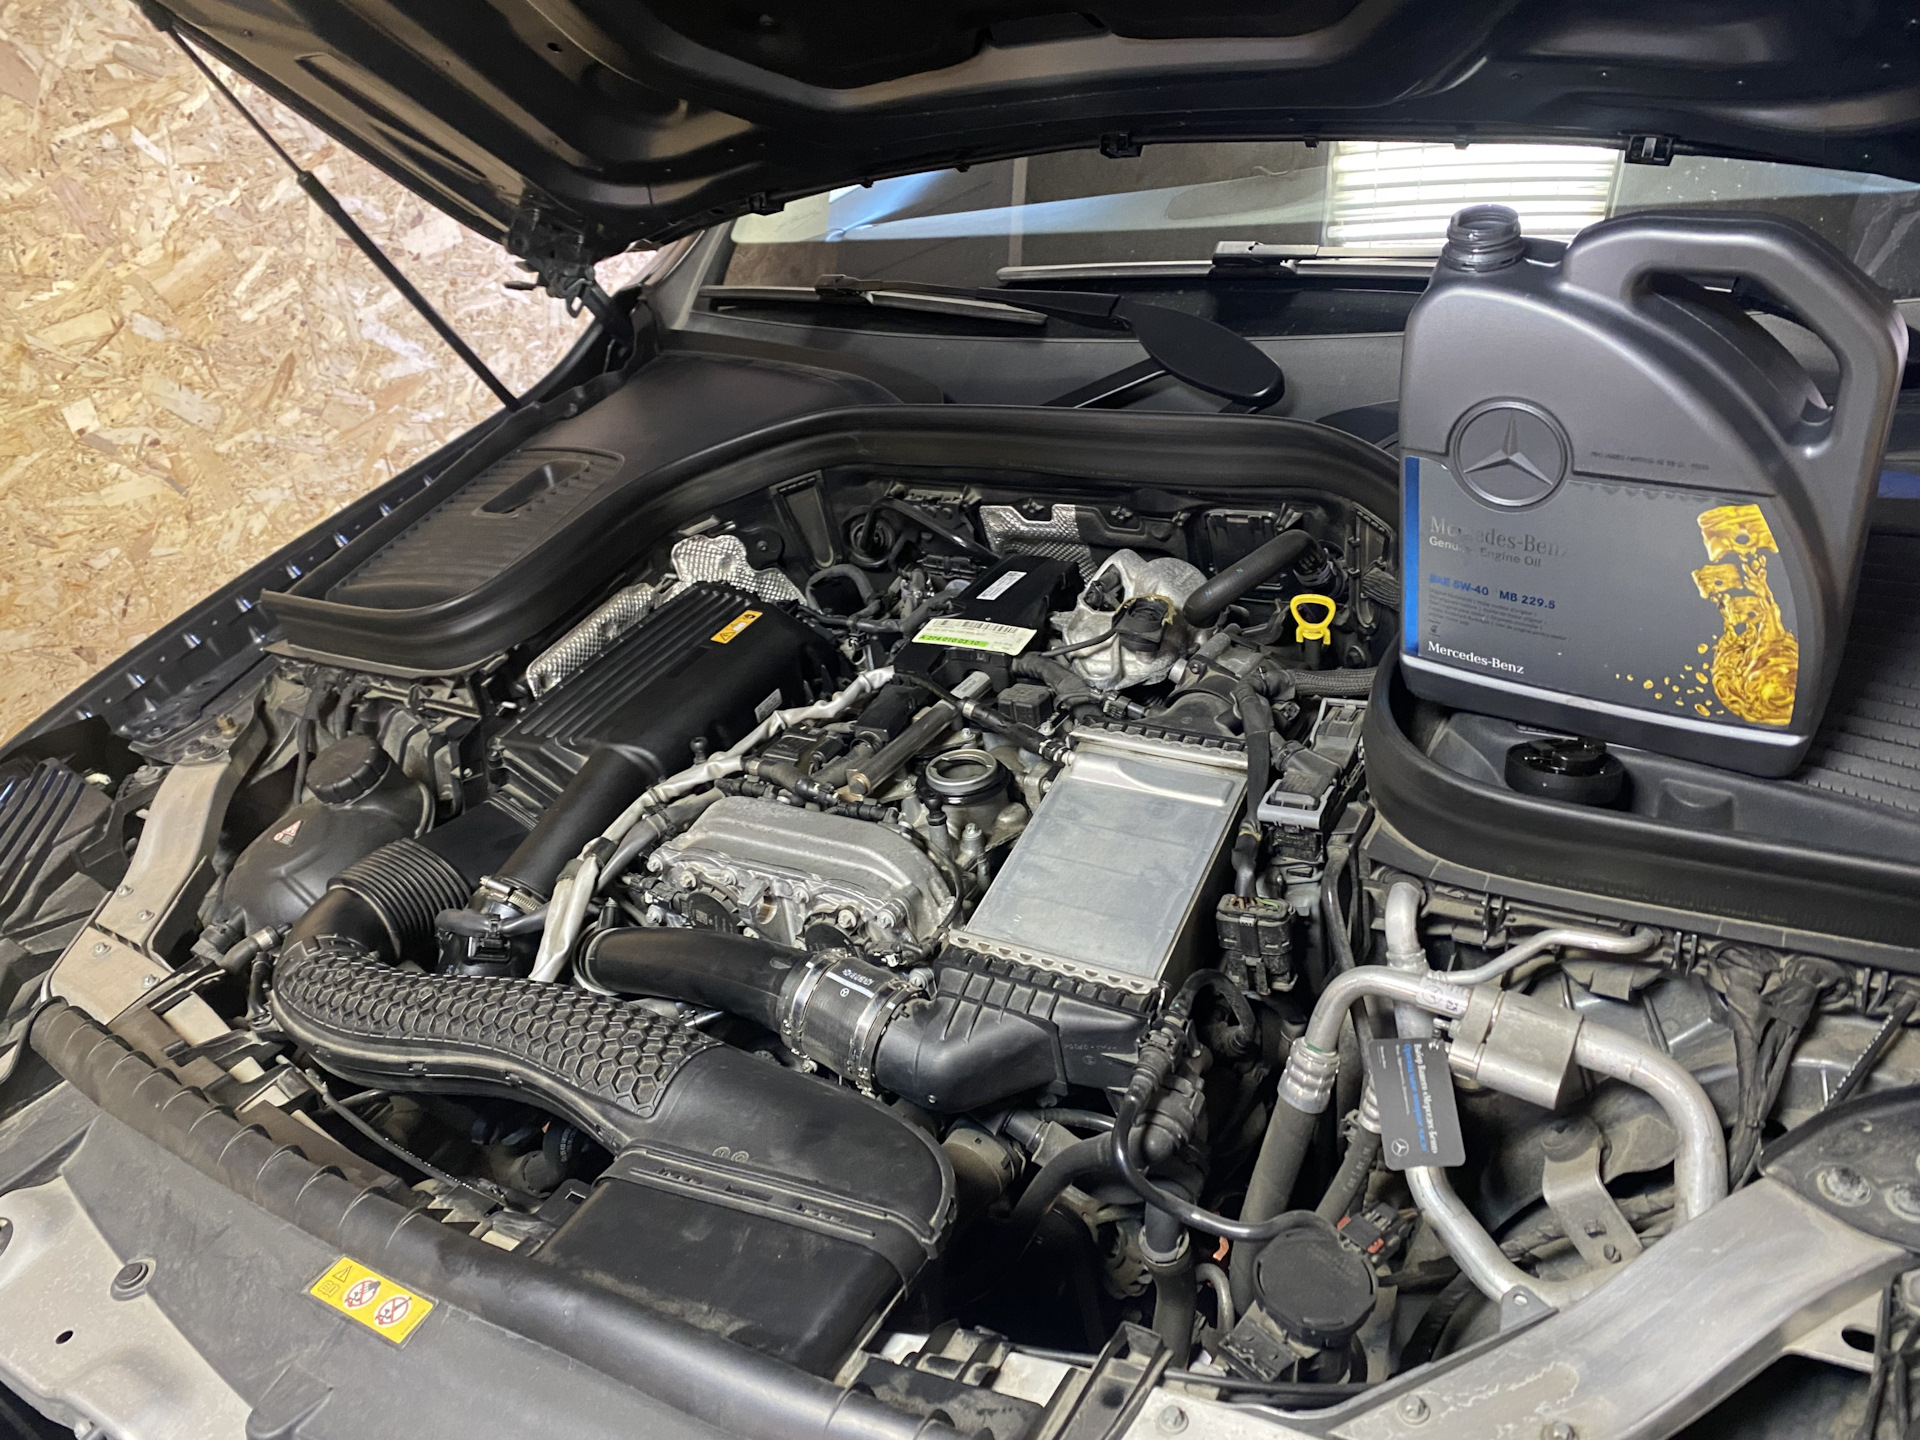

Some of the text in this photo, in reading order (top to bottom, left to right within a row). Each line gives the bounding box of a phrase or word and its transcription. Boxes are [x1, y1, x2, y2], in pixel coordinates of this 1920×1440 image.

[1524, 555, 1541, 568] Oil
[1452, 579, 1490, 597] 5W-40
[1499, 590, 1518, 602] MB
[1521, 595, 1556, 610] 229.5
[1427, 640, 1525, 675] Mercedes-Benz
